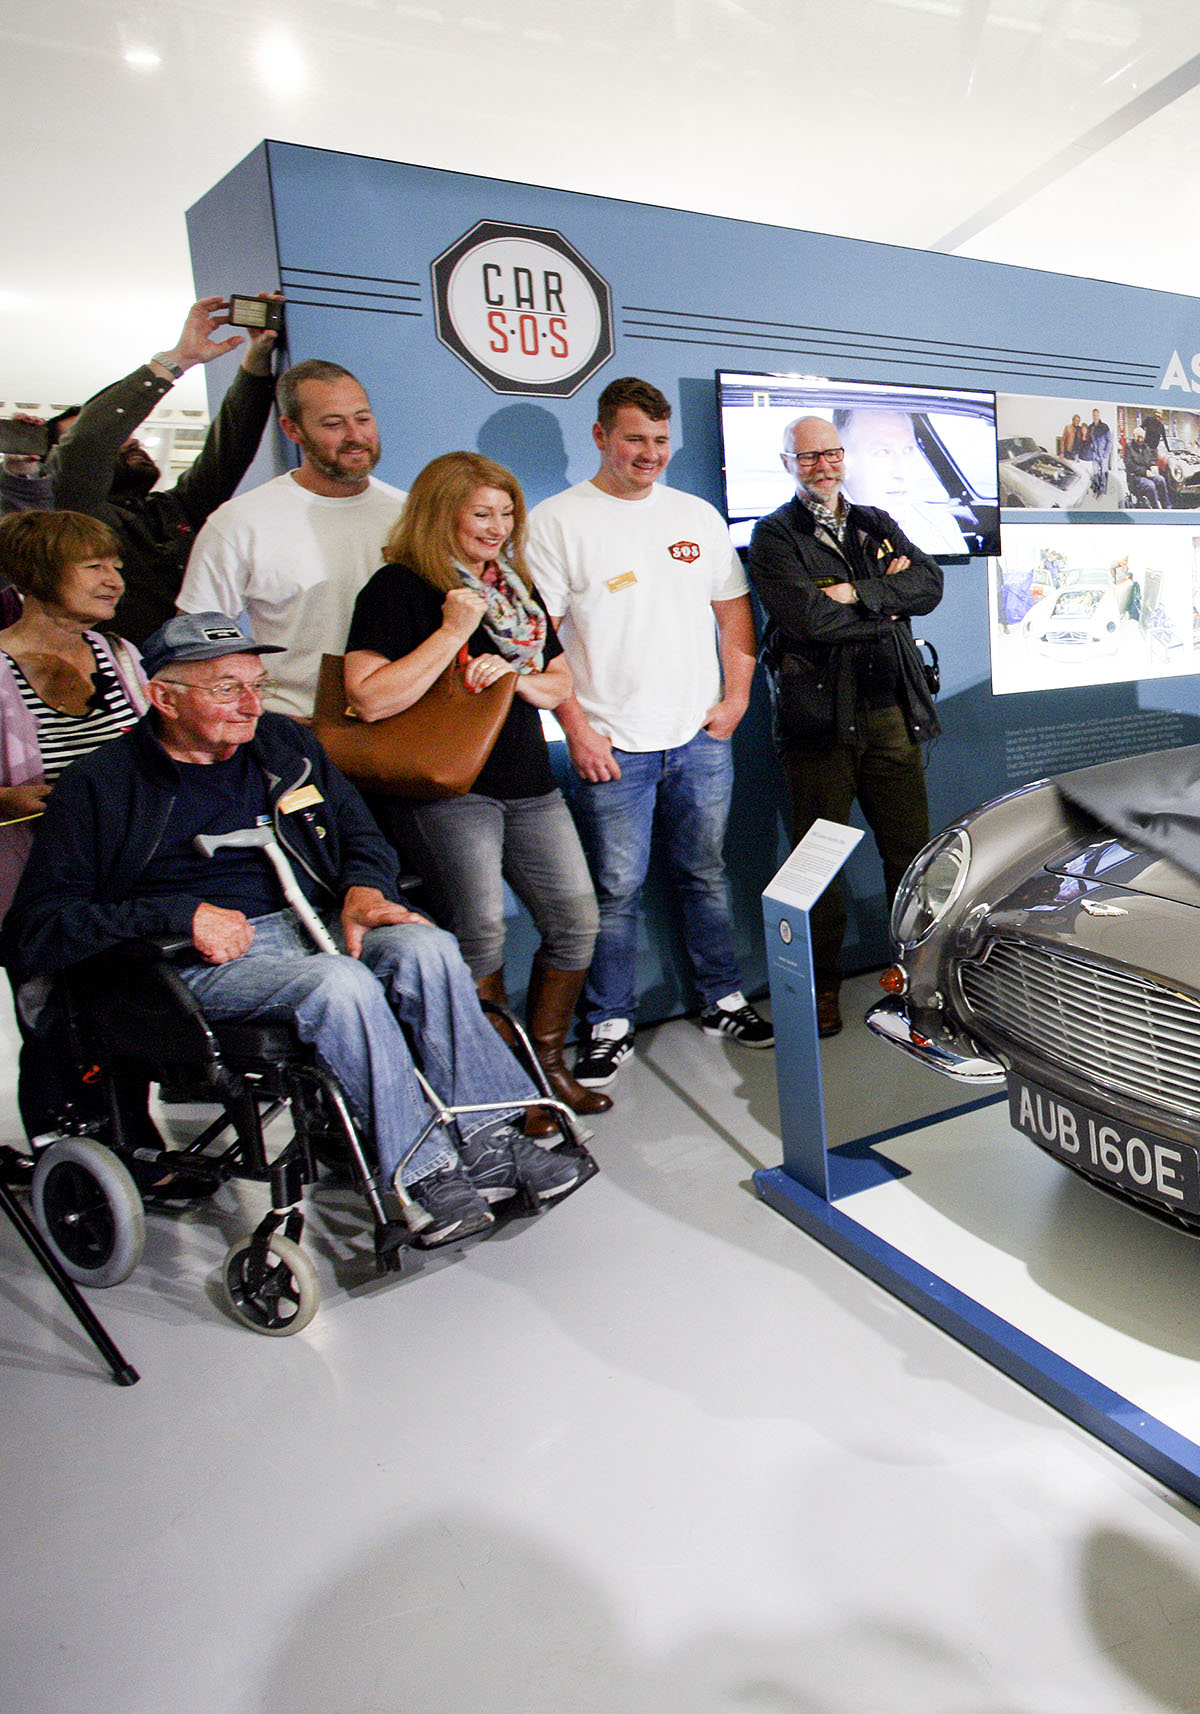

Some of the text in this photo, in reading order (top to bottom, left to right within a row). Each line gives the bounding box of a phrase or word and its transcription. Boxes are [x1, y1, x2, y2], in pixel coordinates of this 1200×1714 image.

[483, 263, 565, 313] CAR
[672, 545, 699, 558] SOS
[1019, 1085, 1184, 1200] AUB 160E
